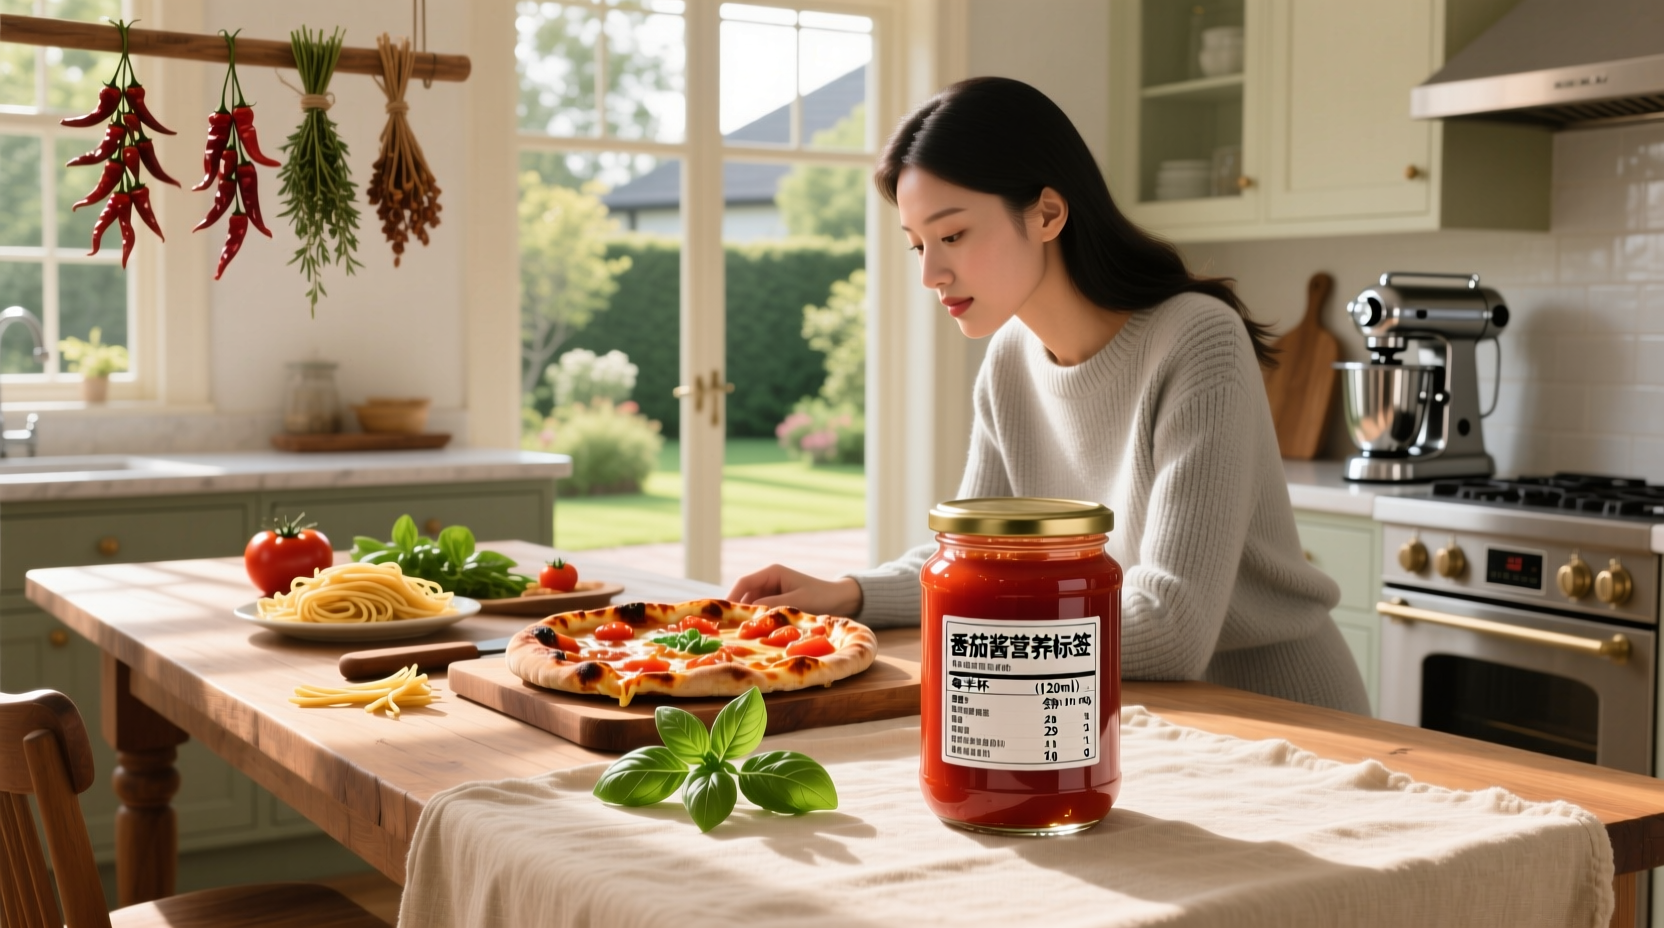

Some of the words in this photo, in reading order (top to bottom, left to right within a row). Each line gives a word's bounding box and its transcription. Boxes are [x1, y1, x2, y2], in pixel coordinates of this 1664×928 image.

[950, 632, 1092, 660] 番茄酱营养标签
[1035, 679, 1080, 695] (120ml)
[1044, 726, 1059, 737] 29
